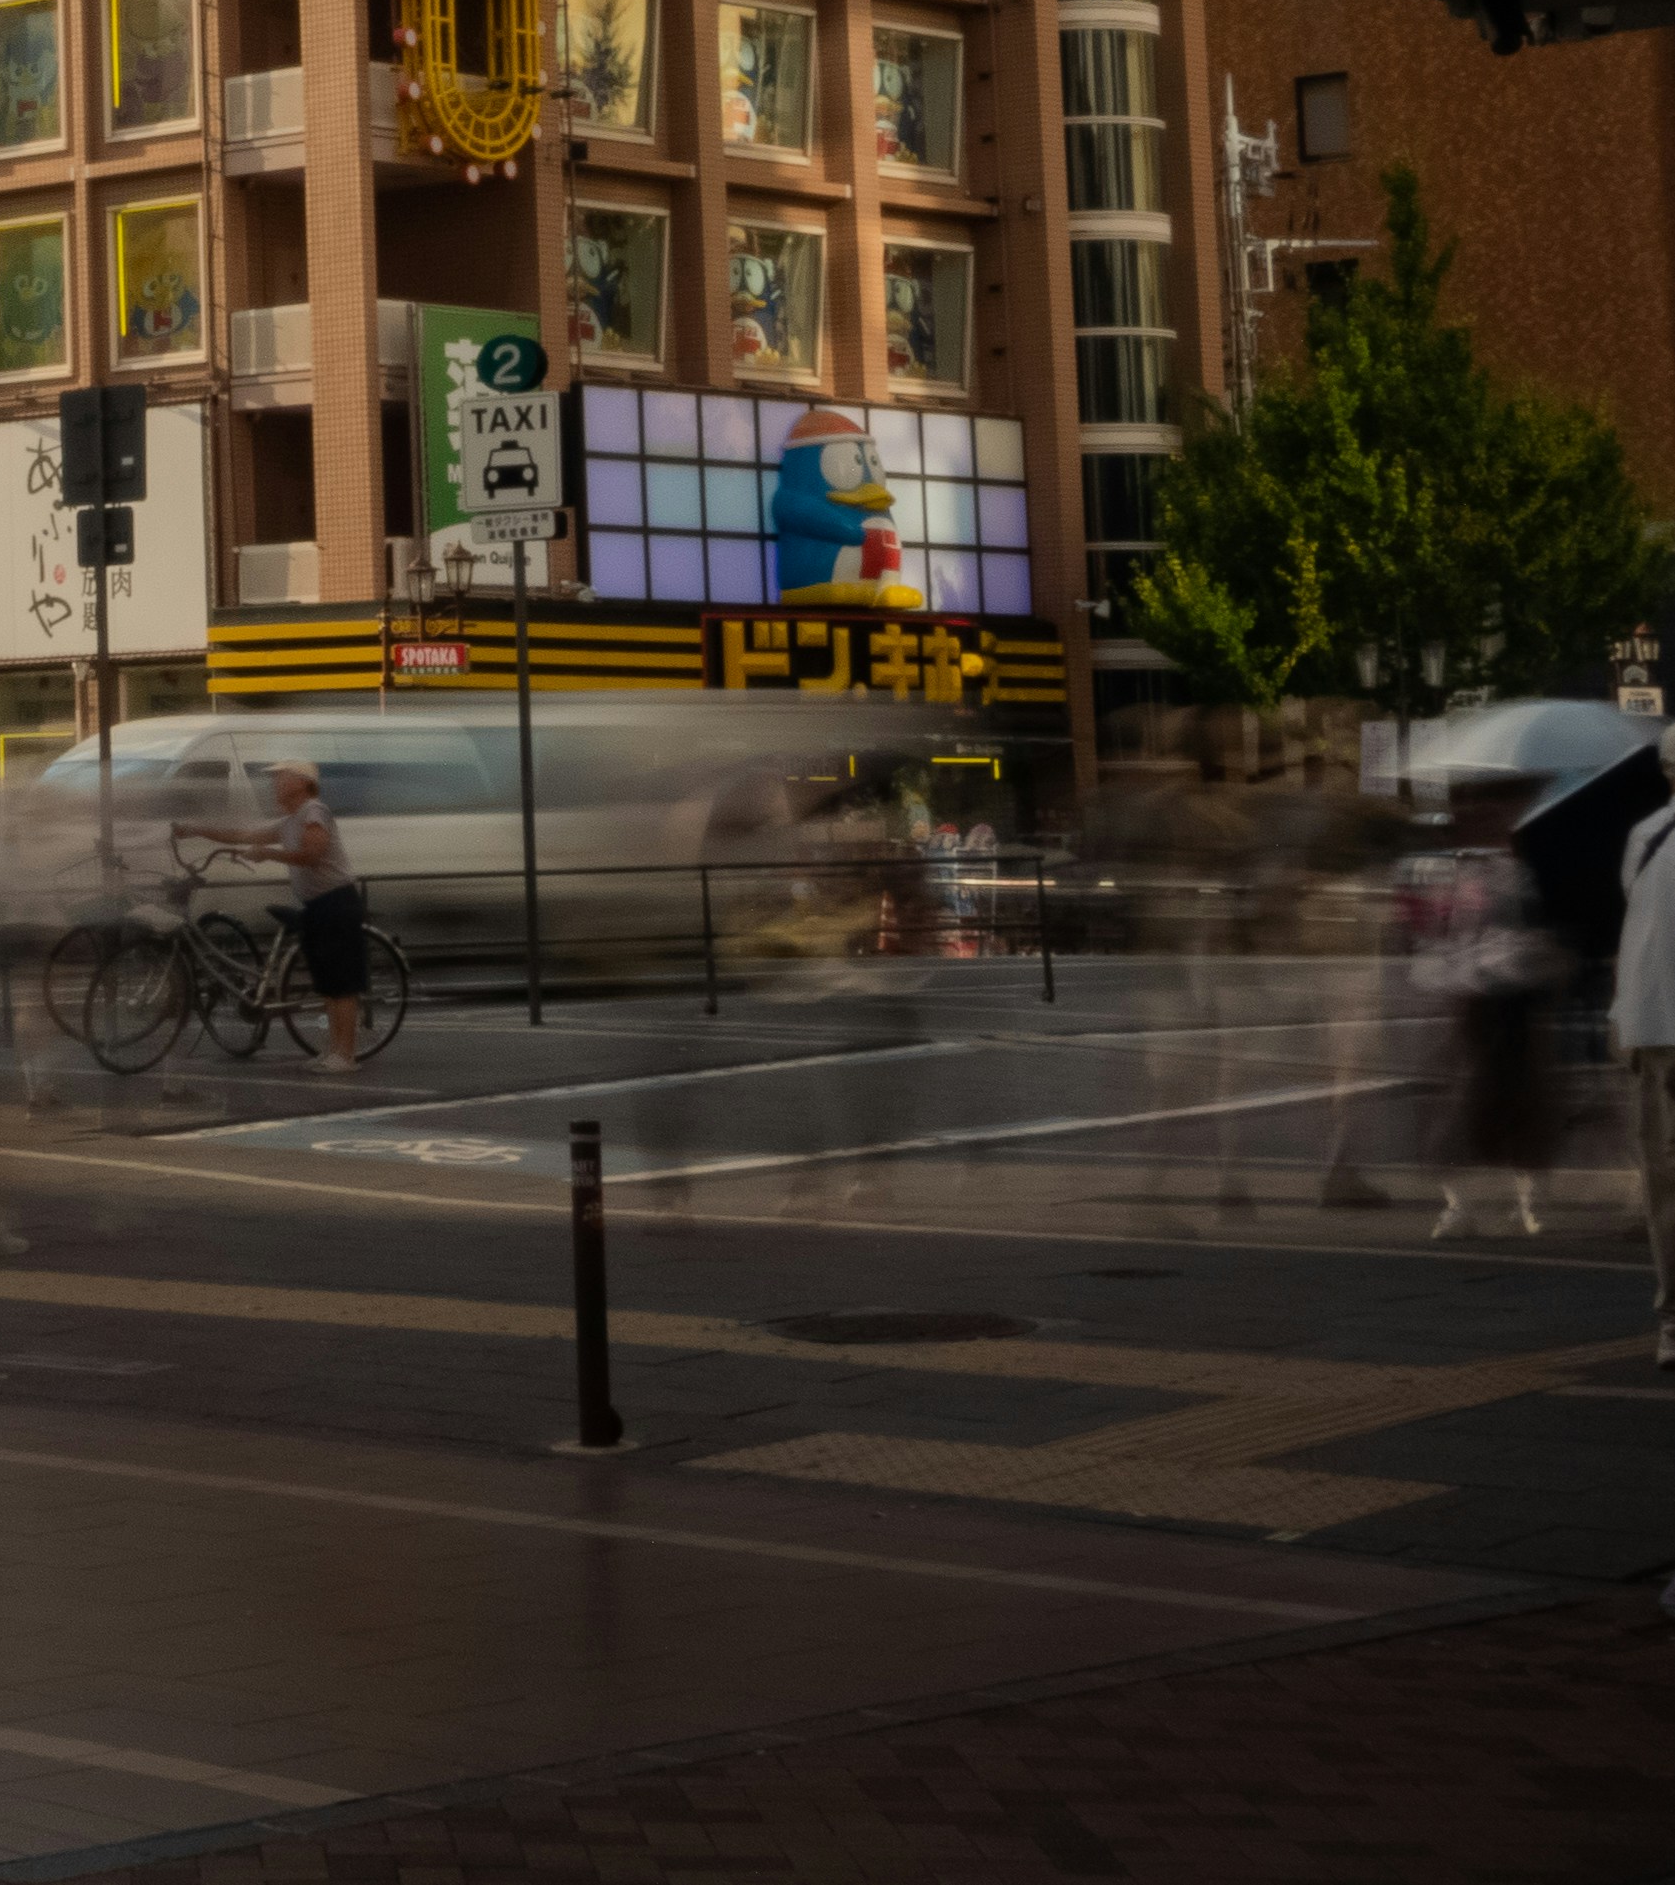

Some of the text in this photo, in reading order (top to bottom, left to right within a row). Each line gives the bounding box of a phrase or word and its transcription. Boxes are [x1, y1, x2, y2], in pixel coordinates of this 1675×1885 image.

[493, 343, 521, 386] 2
[471, 403, 548, 434] TAXI
[401, 647, 459, 667] SPOTAKA
